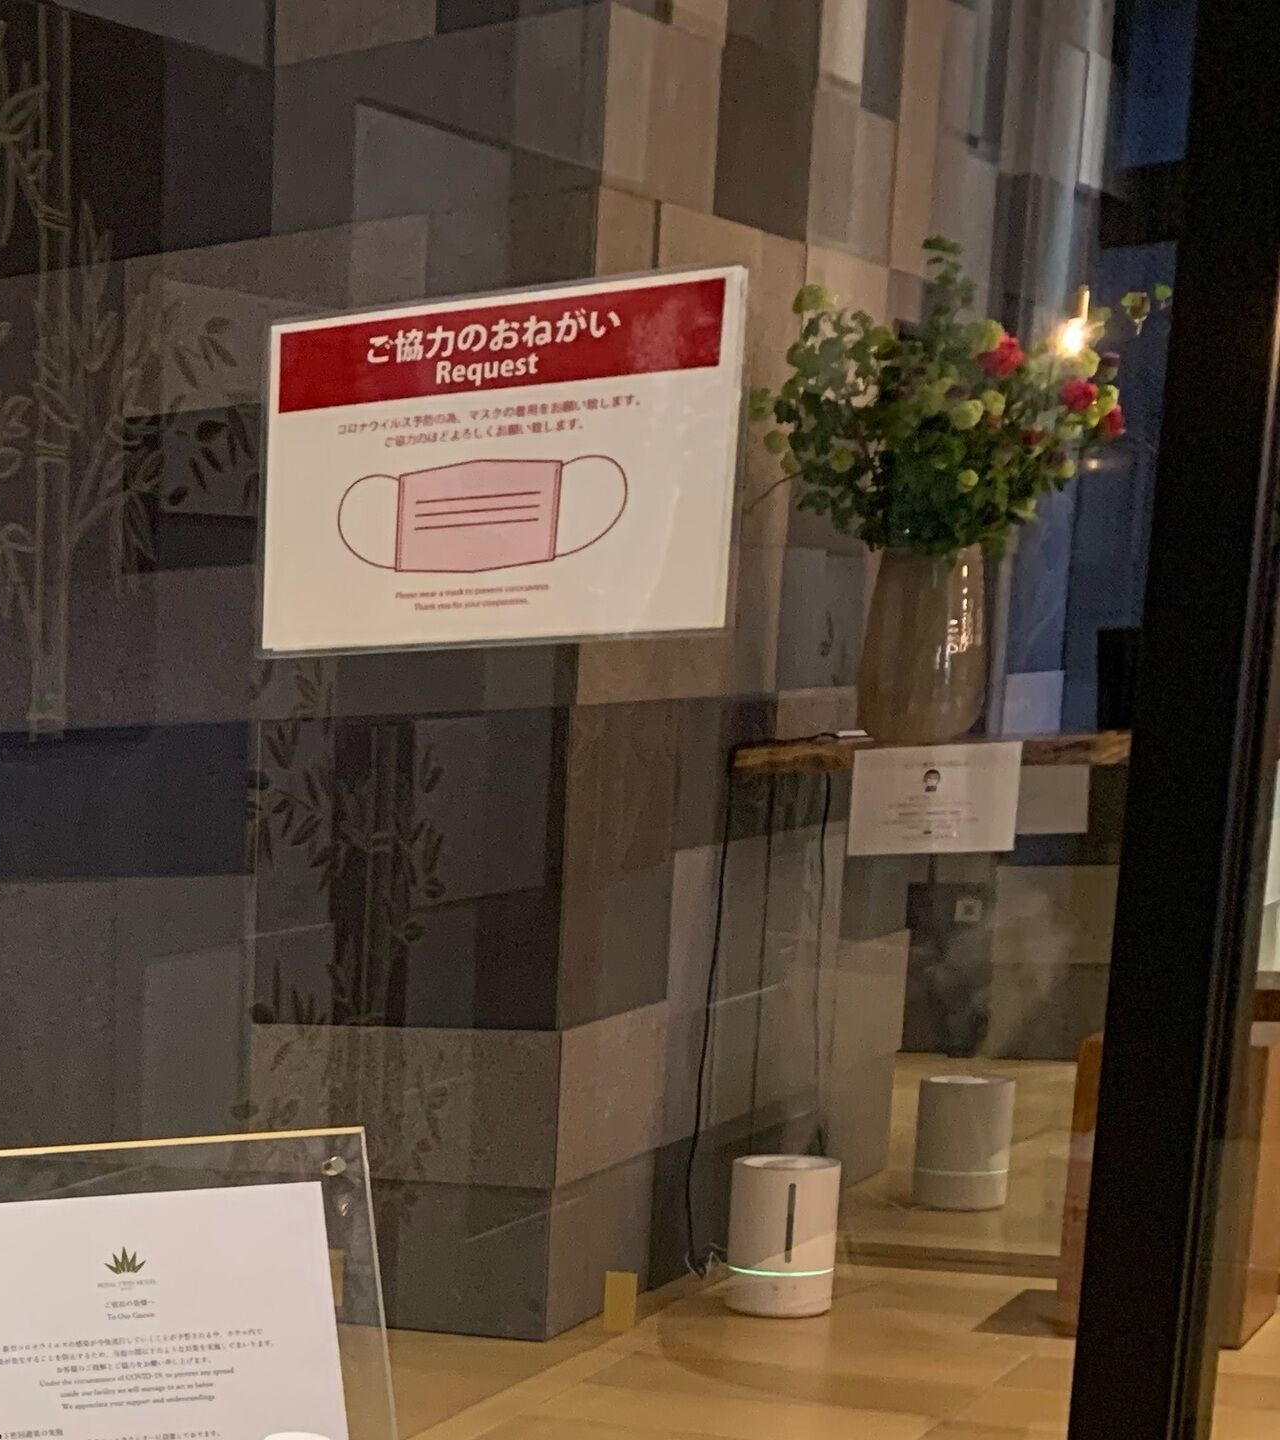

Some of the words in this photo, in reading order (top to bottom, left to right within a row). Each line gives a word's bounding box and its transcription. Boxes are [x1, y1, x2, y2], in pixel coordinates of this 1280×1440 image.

[366, 307, 622, 365] ご協力のおねがい
[435, 352, 540, 387] Request
